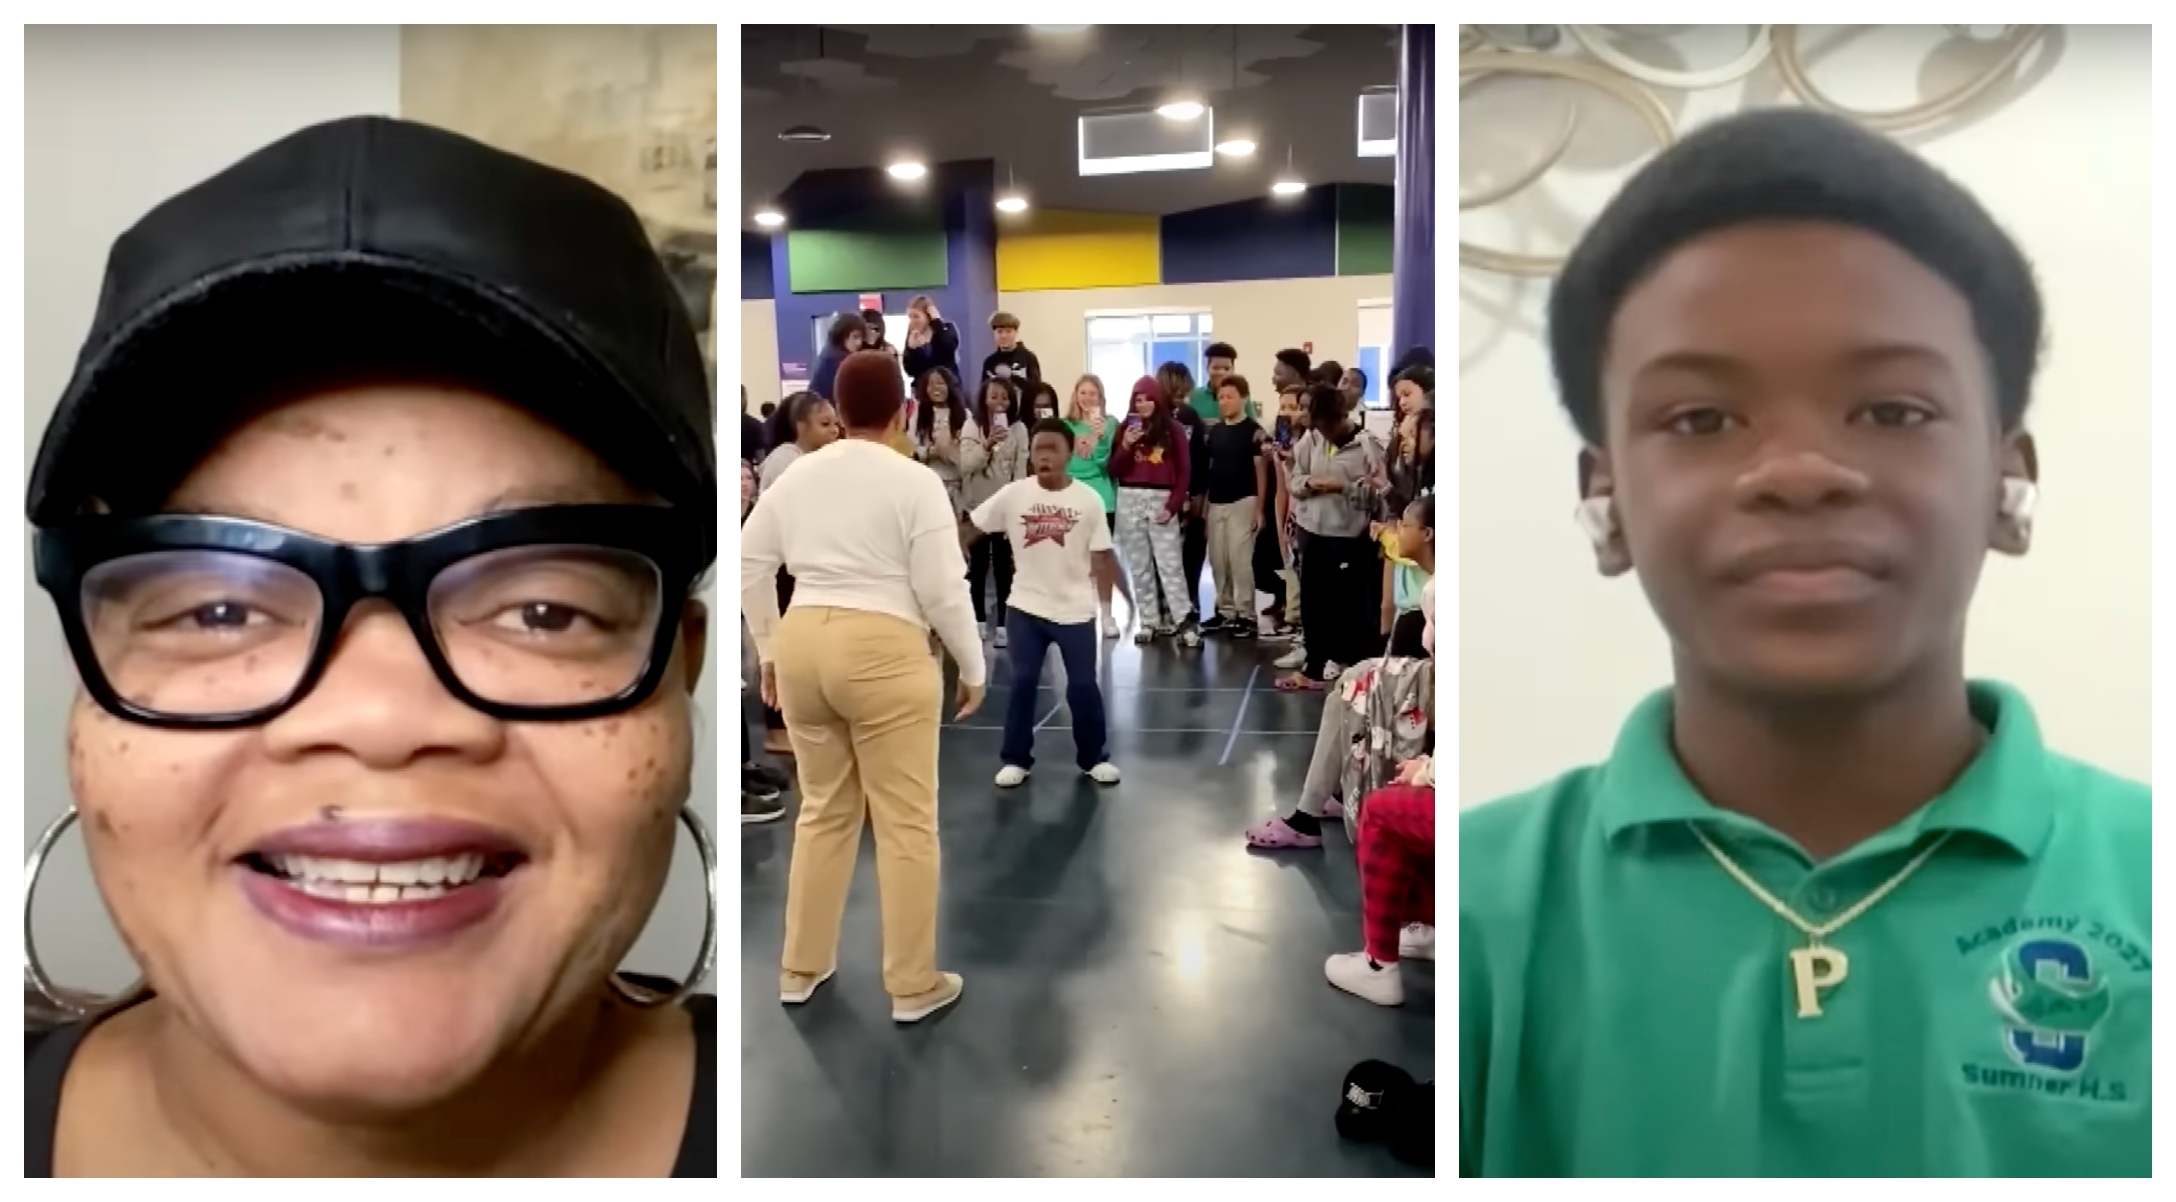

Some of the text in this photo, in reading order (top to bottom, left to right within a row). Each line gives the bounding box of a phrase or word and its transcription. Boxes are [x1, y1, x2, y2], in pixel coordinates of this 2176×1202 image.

[1956, 915, 2152, 972] Academy 2027
[1789, 947, 1848, 1019] P
[1962, 1062, 2074, 1096] Sumner
